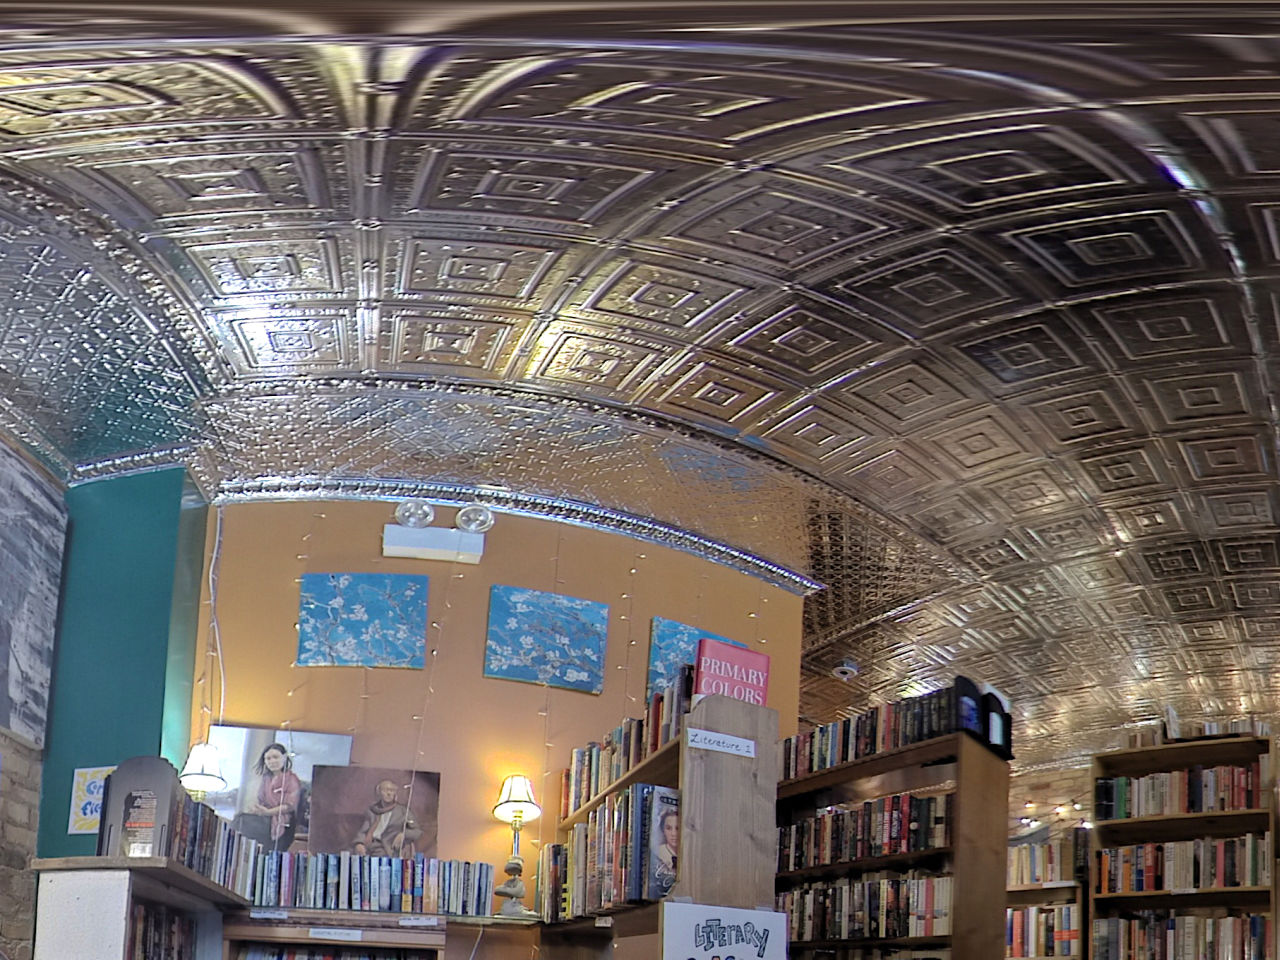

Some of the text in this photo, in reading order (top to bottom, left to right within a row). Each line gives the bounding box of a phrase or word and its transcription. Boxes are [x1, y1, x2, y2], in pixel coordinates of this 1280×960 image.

[701, 656, 768, 687] PRIMARY
[701, 677, 764, 706] COLORS
[690, 733, 741, 751] Literature
